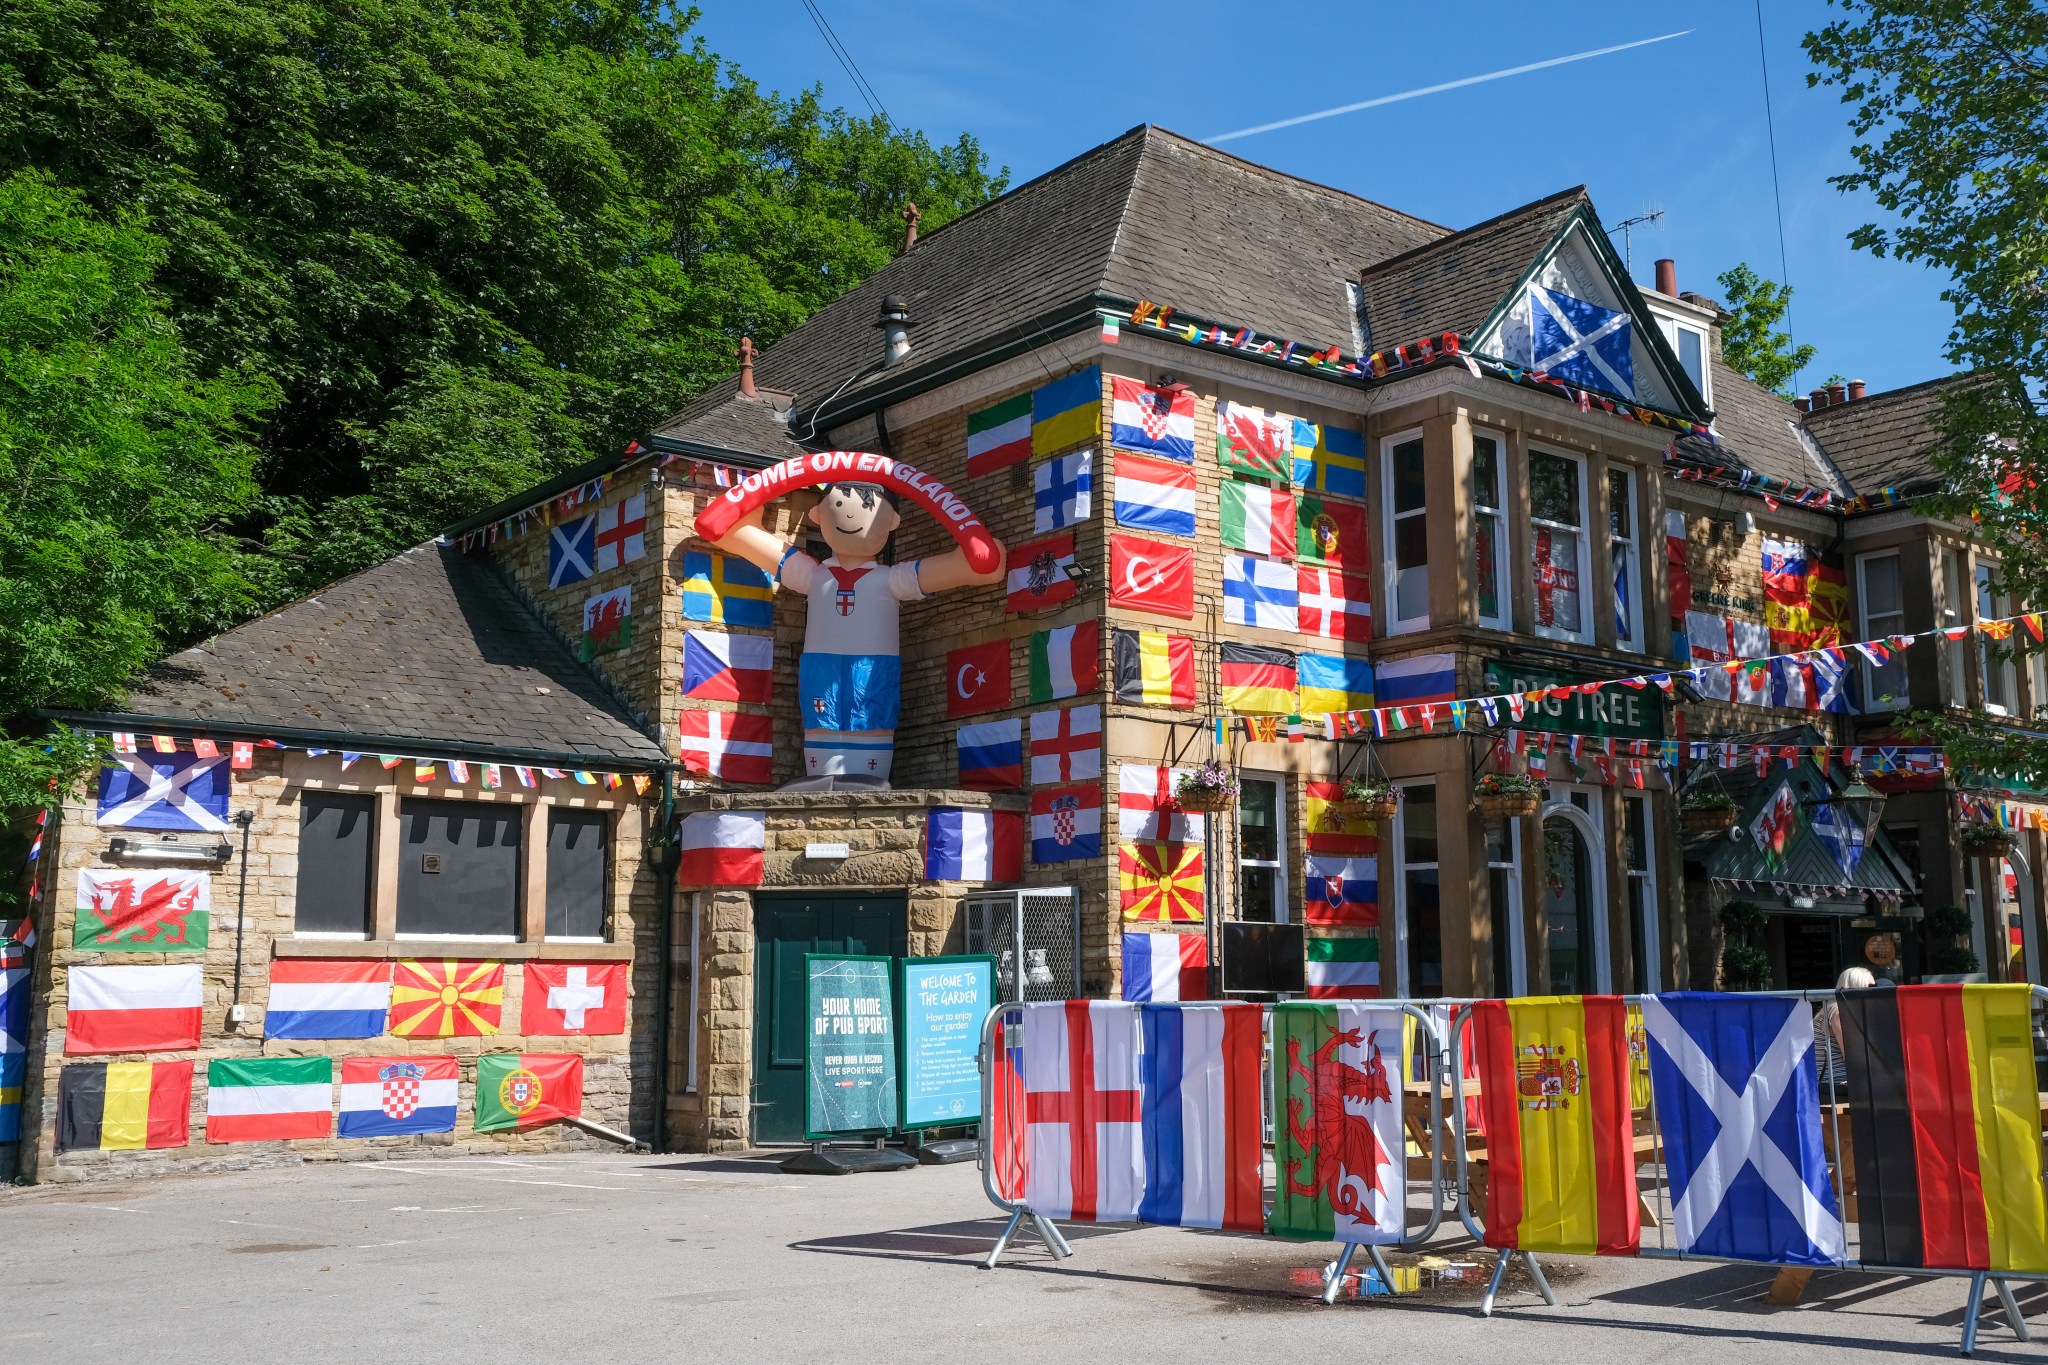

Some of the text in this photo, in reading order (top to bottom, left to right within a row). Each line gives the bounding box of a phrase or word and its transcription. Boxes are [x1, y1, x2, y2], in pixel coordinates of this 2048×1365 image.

[724, 451, 981, 531] COME ON ENGLAND!
[1692, 591, 1731, 607] GREENE
[1733, 597, 1756, 612] KING
[1512, 678, 1642, 728] BIG TREE
[920, 972, 976, 990] WELCOME TO
[822, 997, 881, 1015] YOUR HOME
[919, 989, 977, 1006] THE GARDEN
[815, 1016, 888, 1035] OF PUB SPORT
[926, 1011, 973, 1022] How to enjoy
[930, 1021, 969, 1033] our garden
[824, 1054, 883, 1065] NEVER MISS A SECOND
[825, 1066, 884, 1076] LIVE SPORT HERE
